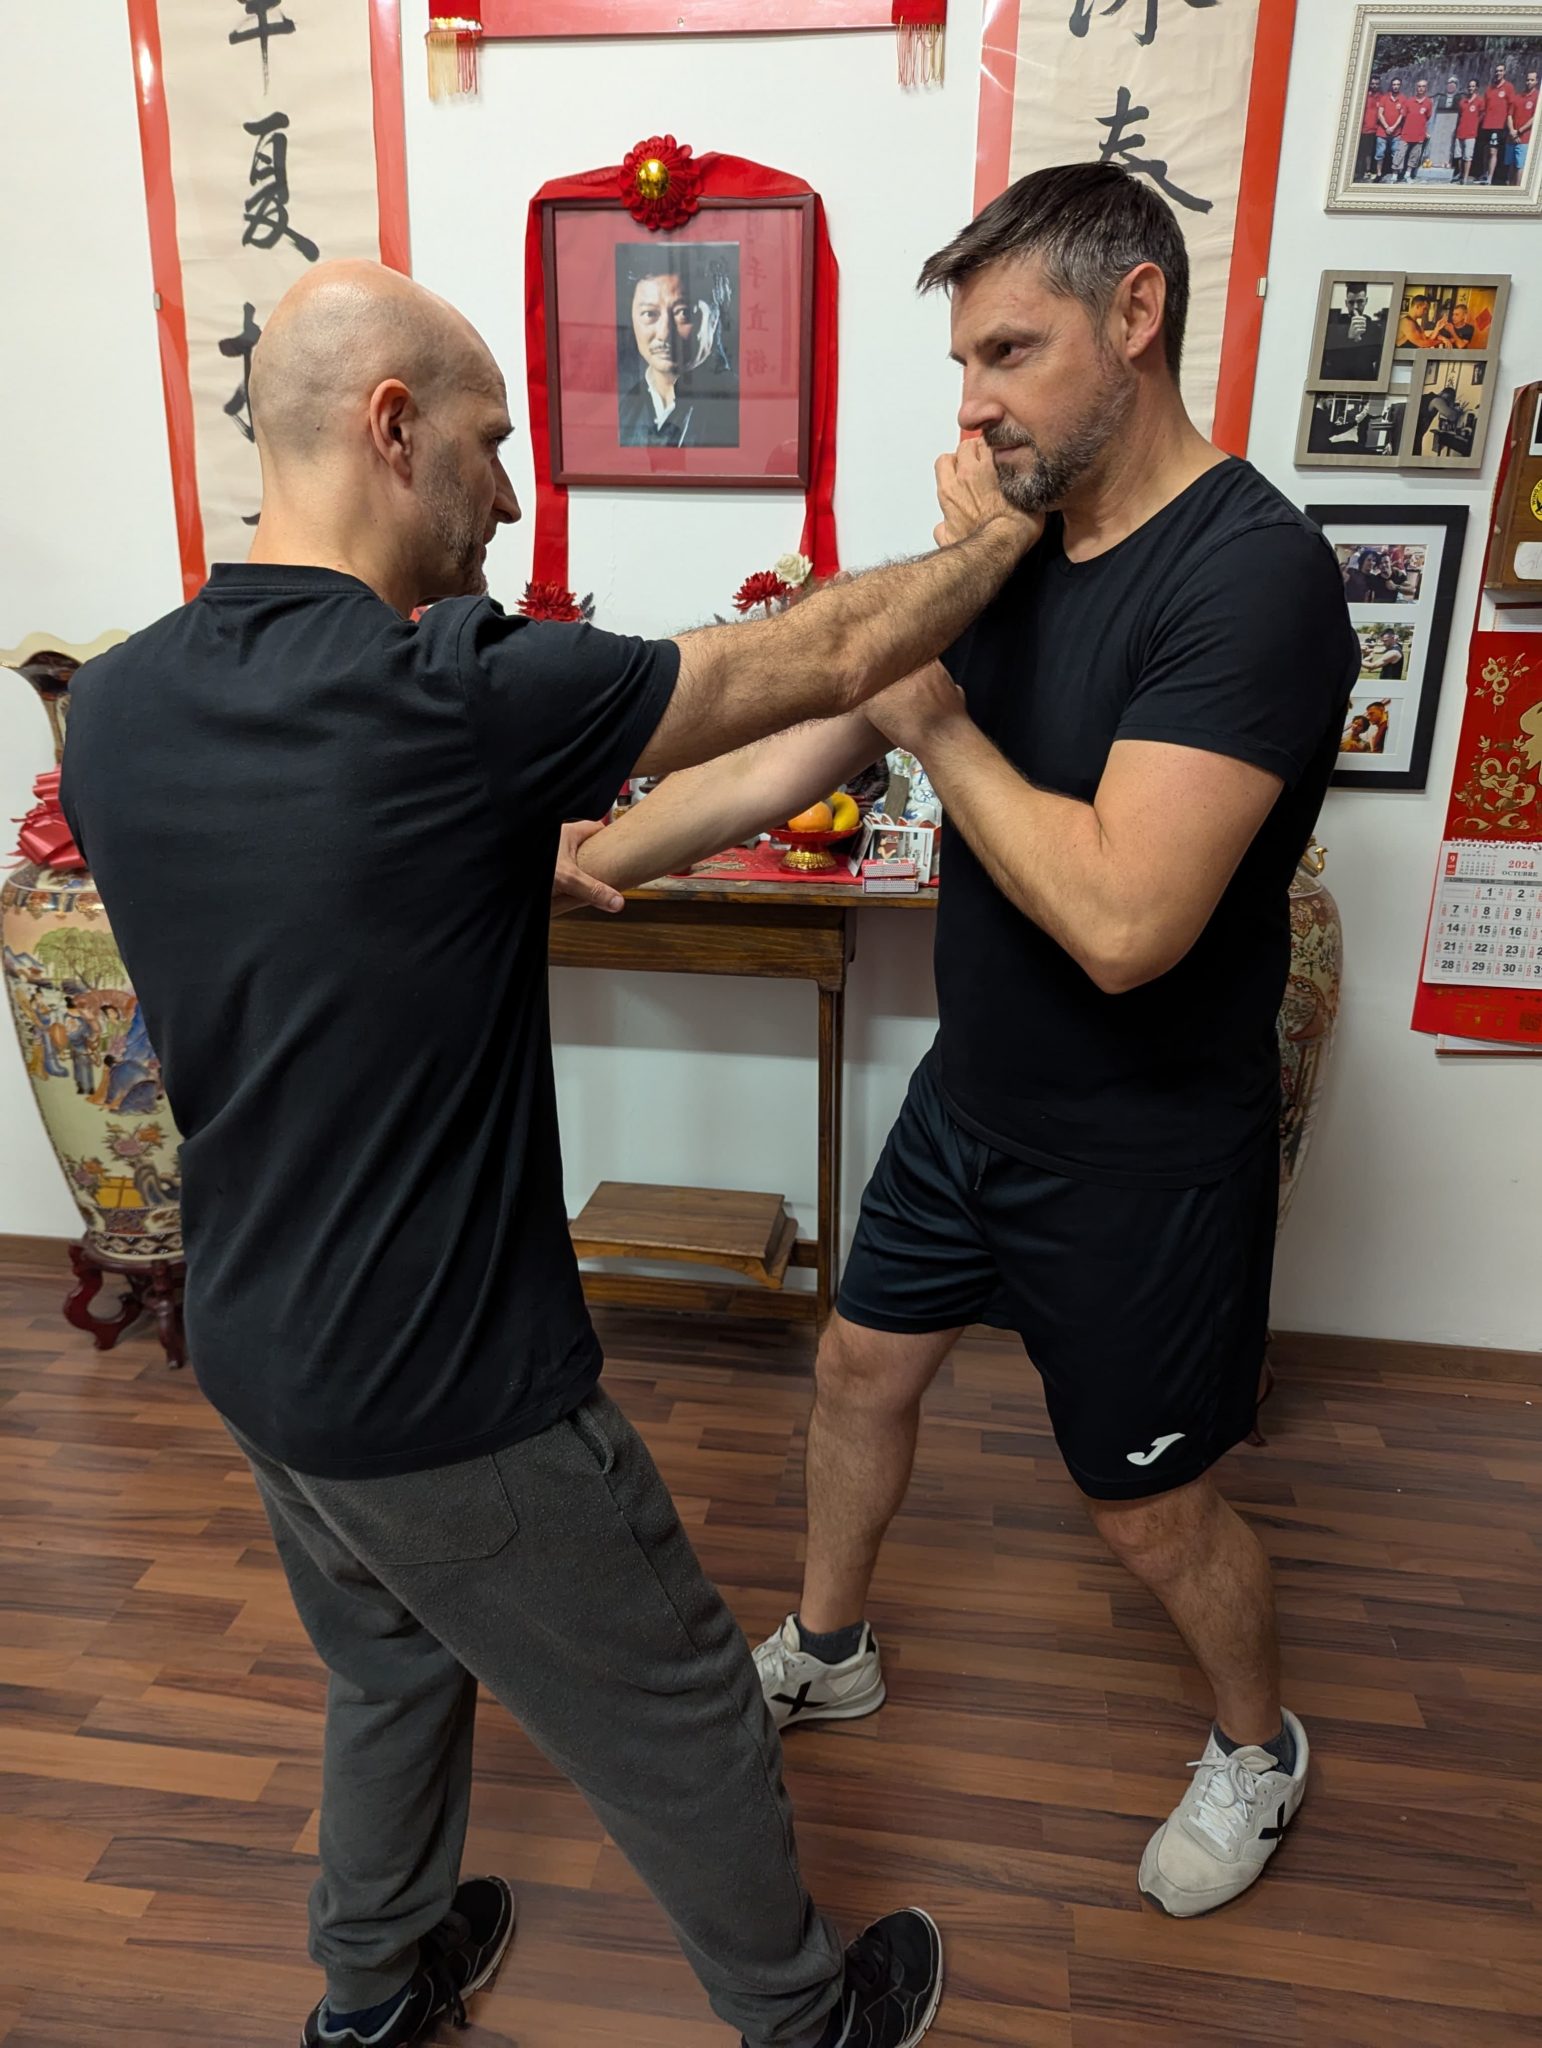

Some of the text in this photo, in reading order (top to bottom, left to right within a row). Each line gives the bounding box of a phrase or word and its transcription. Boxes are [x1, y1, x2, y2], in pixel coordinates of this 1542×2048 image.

[1508, 860, 1535, 869] 2024
[1487, 887, 1525, 898] 1 2
[1452, 904, 1522, 917] 7 8 9
[1446, 923, 1522, 936] 14 15 16
[1443, 941, 1456, 951] 21
[1474, 943, 1488, 952] 22
[1505, 945, 1519, 954] 23
[1441, 960, 1454, 969] 28
[1471, 961, 1485, 971] 29
[1502, 963, 1516, 972] 30
